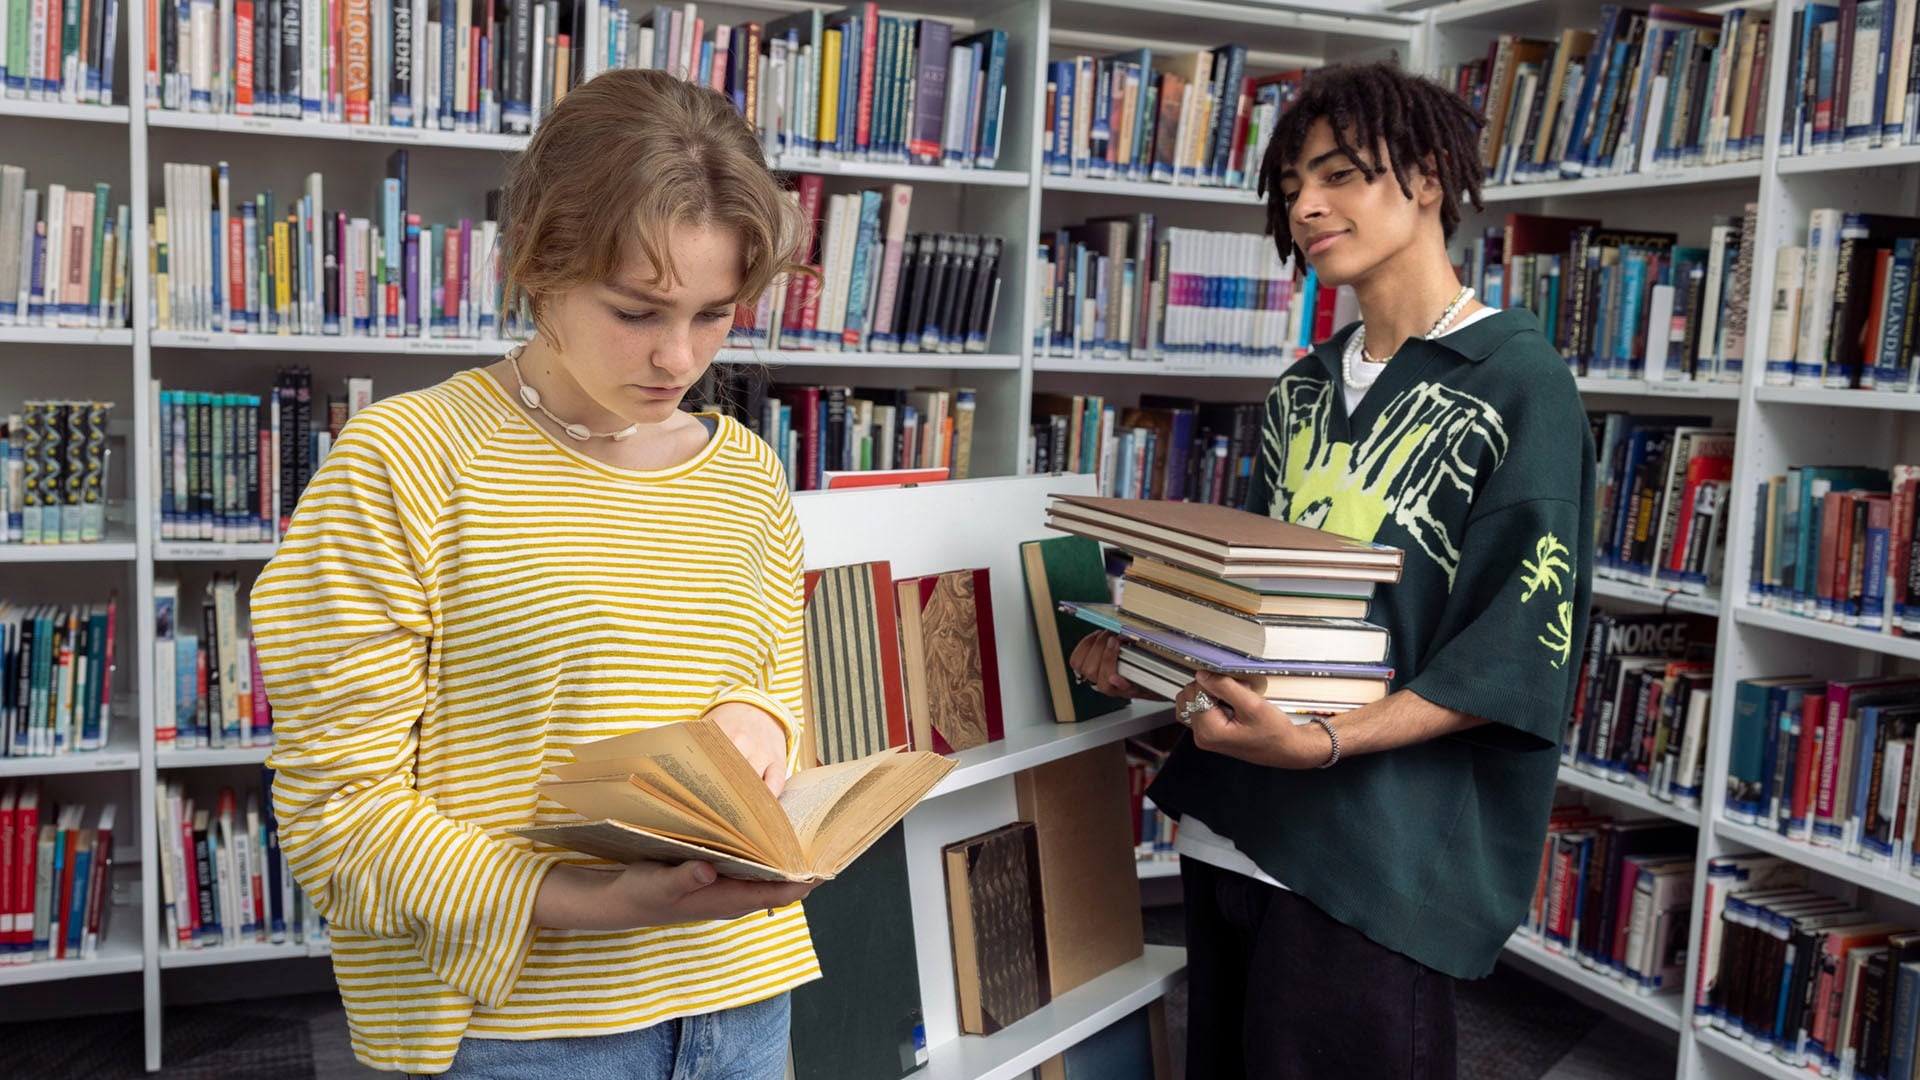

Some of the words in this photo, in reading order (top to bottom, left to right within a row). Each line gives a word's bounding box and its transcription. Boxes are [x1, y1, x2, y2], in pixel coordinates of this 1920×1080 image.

[237, 15, 252, 61] PERIODIC
[394, 7, 411, 81] JORDEN
[236, 61, 251, 88] TALES
[1058, 119, 1070, 155] DYLAN
[1881, 264, 1909, 369] HAVLANDET
[1606, 622, 1688, 654] NORGE
